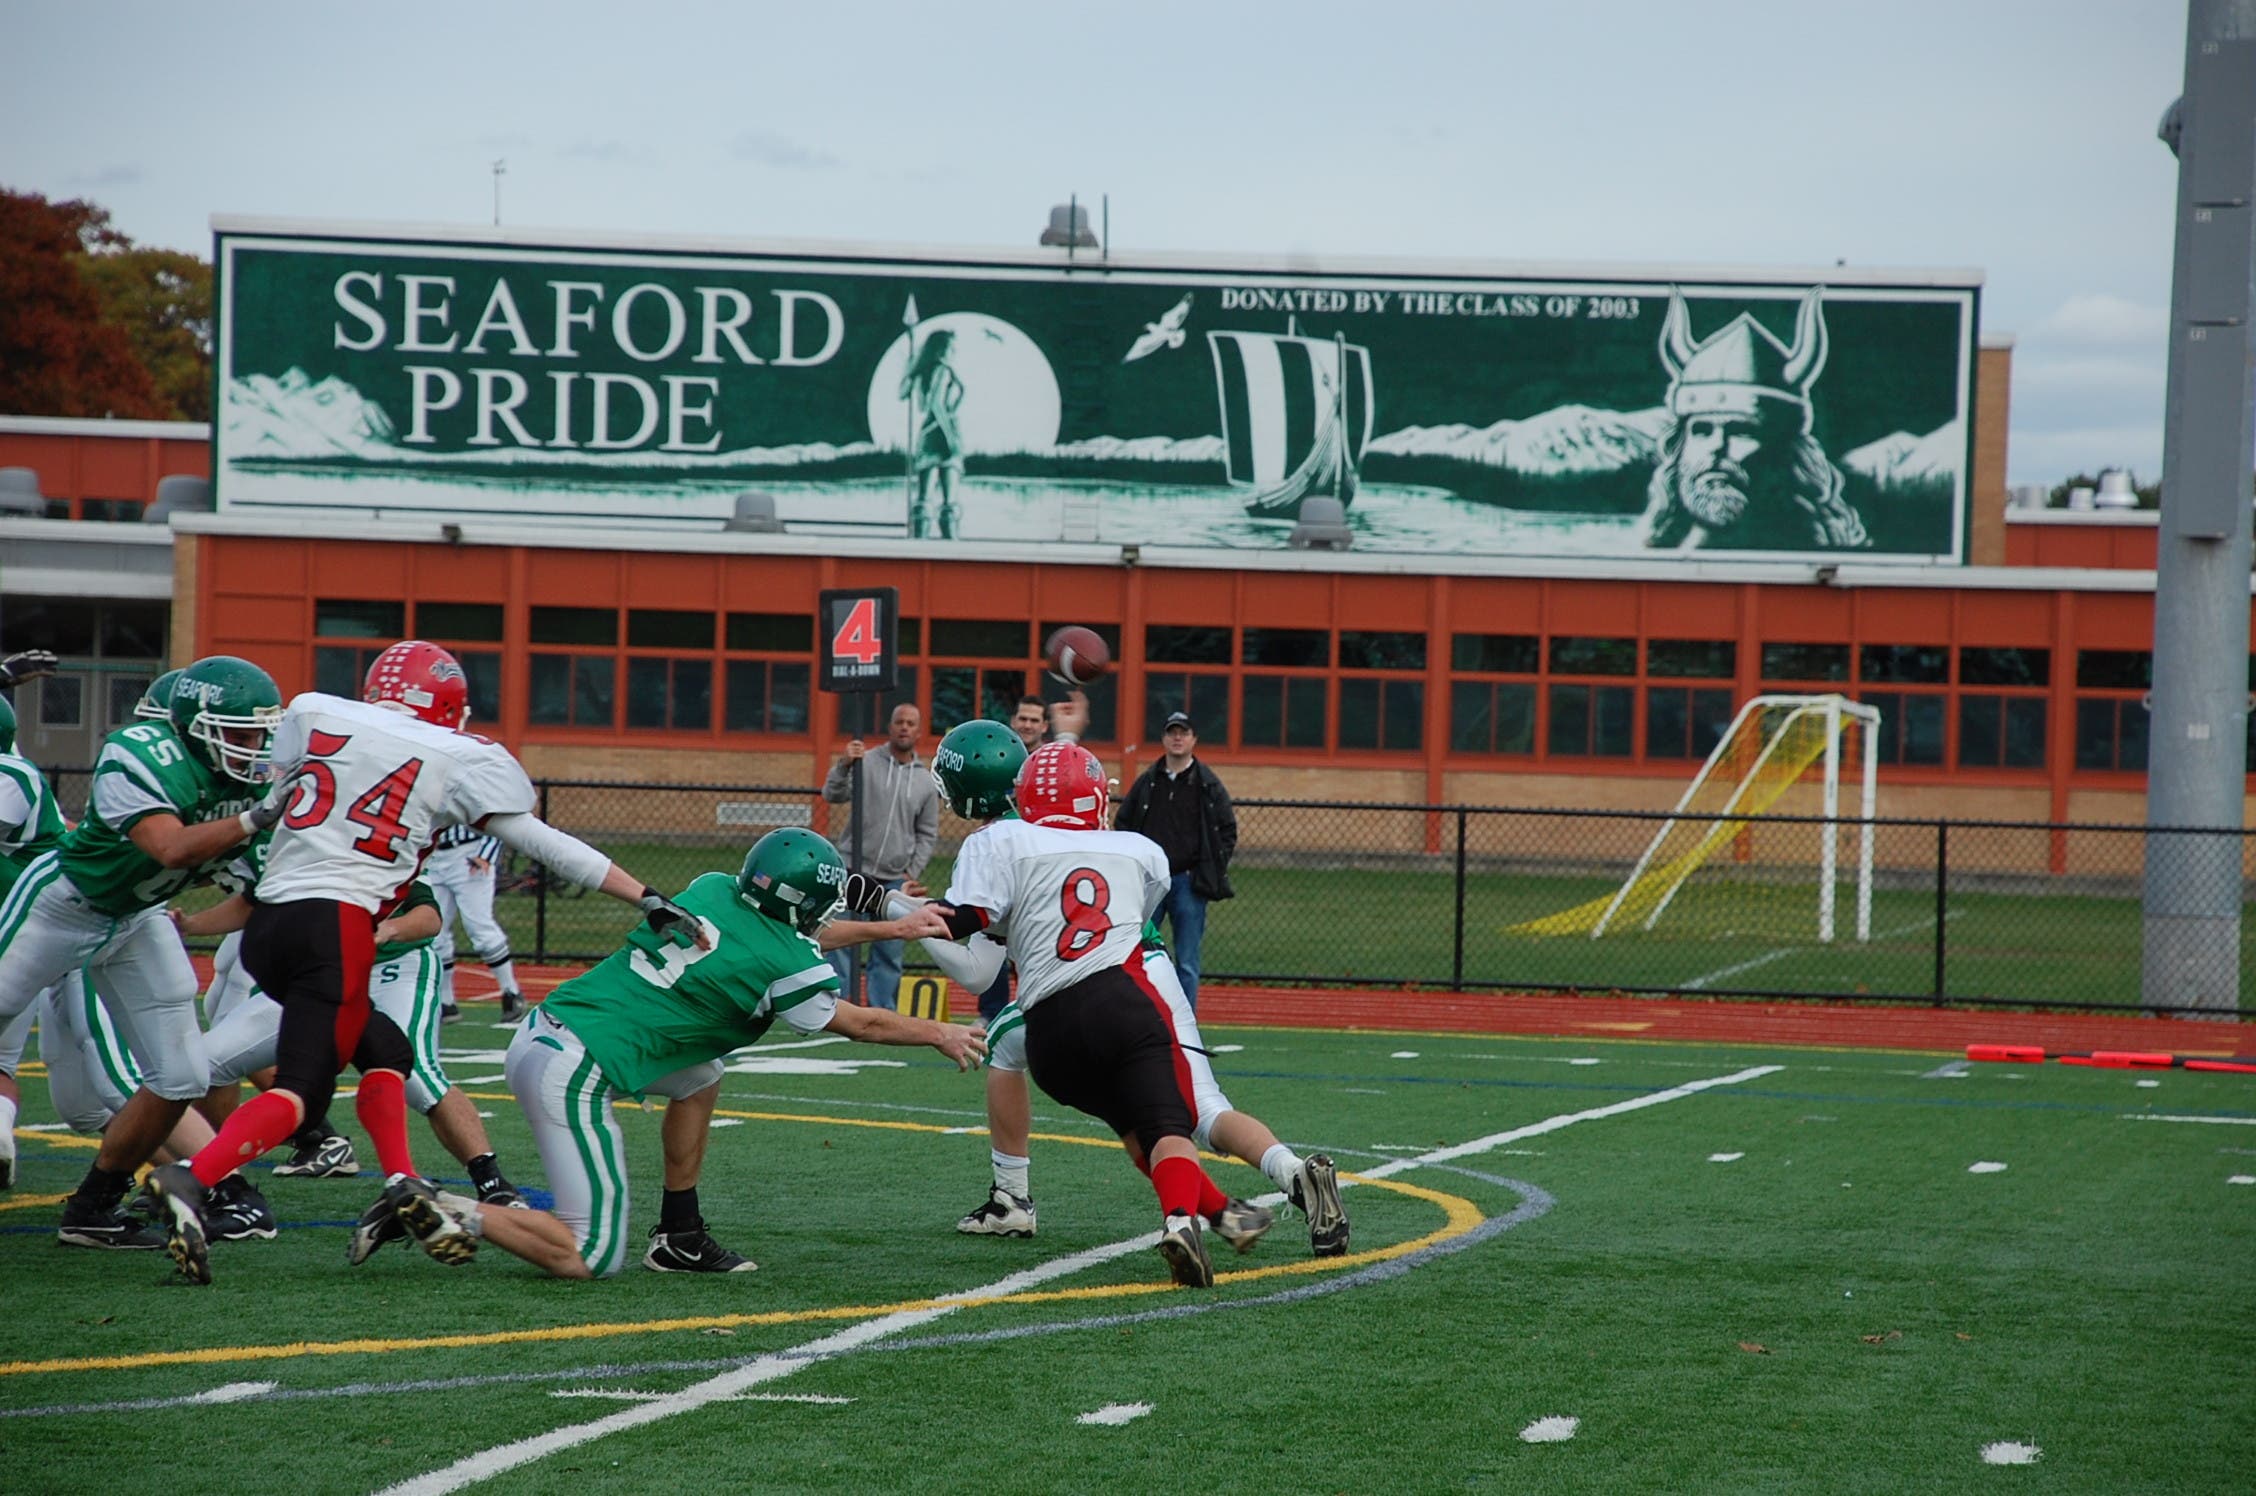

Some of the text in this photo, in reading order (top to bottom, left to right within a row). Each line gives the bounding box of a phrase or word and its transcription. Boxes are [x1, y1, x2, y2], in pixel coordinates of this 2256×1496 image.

[333, 270, 845, 367] SEAFORD
[1221, 287, 1640, 319] DONATED BY THE CLASS OF 2003
[402, 365, 724, 453] PRIDE
[832, 598, 882, 664] 4
[283, 728, 424, 864] 54
[629, 915, 721, 989] 3
[1056, 866, 1114, 963] 8
[380, 964, 400, 984] S
